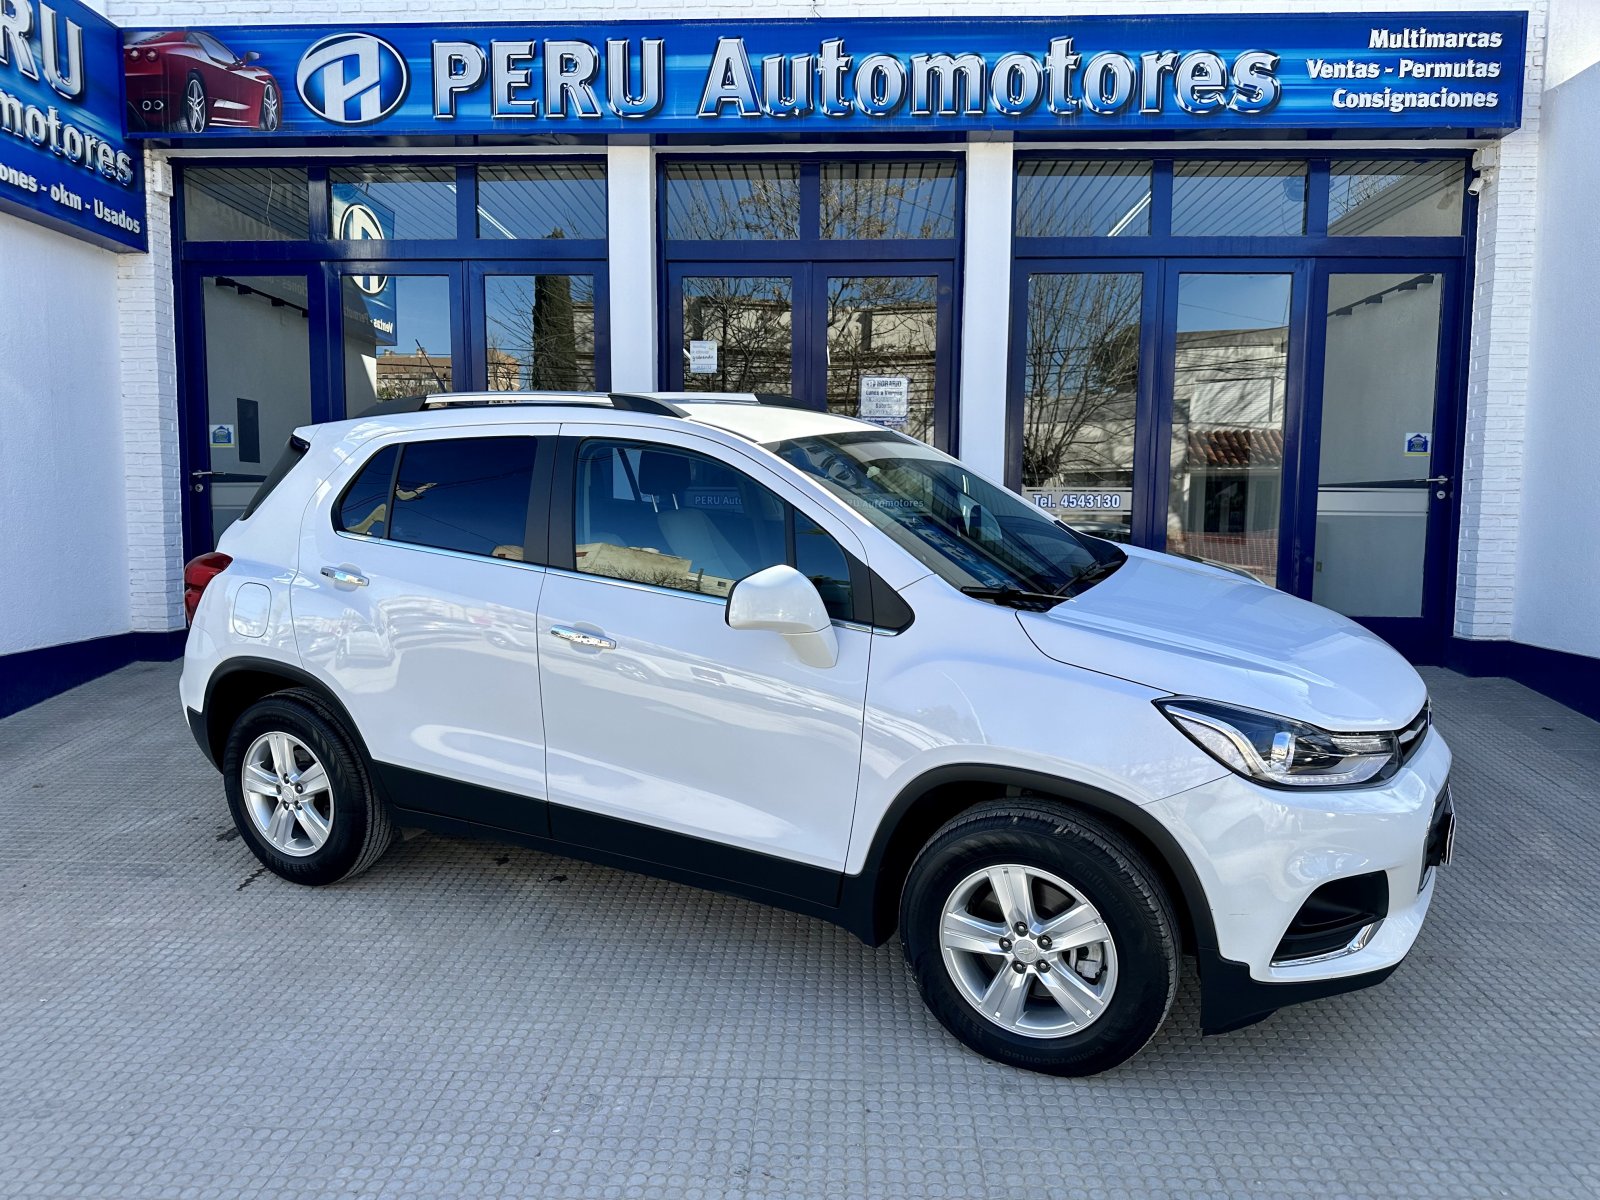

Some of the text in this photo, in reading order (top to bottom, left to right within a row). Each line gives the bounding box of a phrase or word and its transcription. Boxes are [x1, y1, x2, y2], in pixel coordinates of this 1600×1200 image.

[1368, 27, 1502, 48] Multimarcas
[431, 38, 666, 120] PERU
[697, 36, 1282, 120] Automotores
[1306, 58, 1380, 80] Ventas
[1399, 59, 1501, 79] Permutas
[1332, 87, 1499, 113] Consignaciones
[50, 181, 82, 212] okm
[93, 197, 141, 235] Usados
[695, 495, 720, 505] PERU
[1033, 493, 1121, 509] Tel. 4543130
